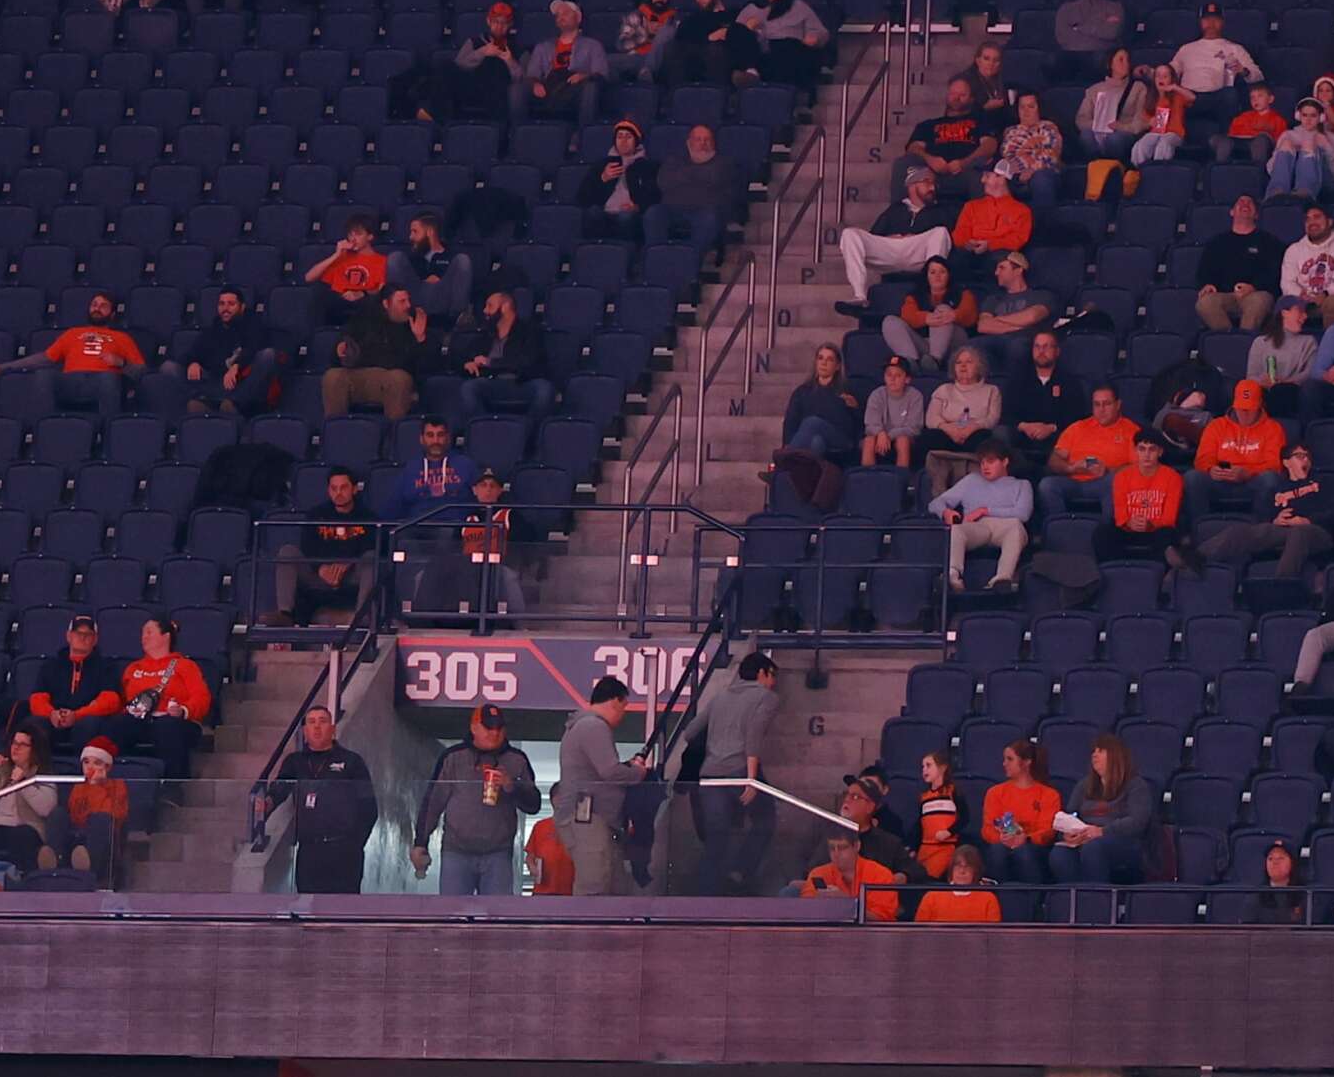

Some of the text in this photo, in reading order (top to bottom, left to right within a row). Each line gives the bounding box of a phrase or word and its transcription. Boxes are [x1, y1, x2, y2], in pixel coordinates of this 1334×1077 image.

[893, 111, 905, 125] T
[869, 147, 881, 163] S
[846, 186, 859, 203] R
[802, 267, 815, 285] P
[755, 353, 770, 373] N
[730, 399, 745, 416] M
[405, 651, 517, 701] 305
[809, 716, 825, 736] G
